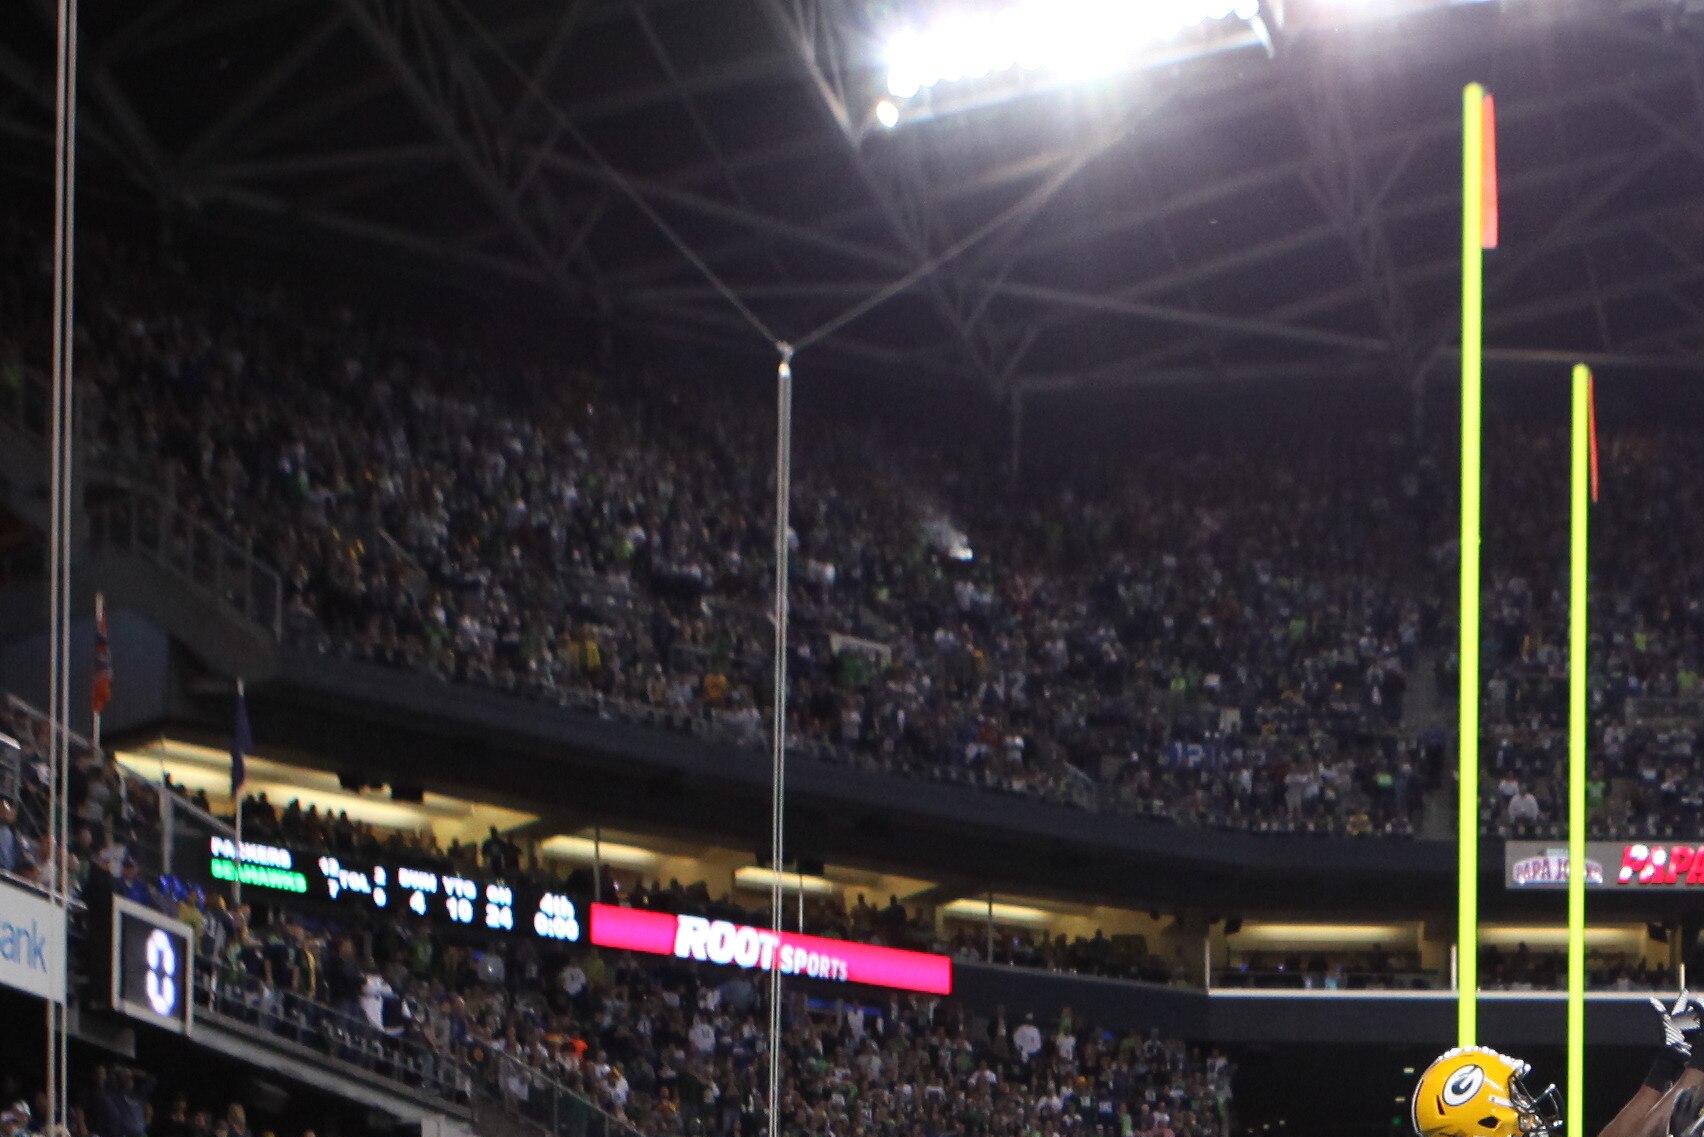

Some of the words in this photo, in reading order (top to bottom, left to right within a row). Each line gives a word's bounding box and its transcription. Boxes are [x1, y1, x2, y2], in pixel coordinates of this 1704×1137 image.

[210, 835, 292, 870] PAKERS
[327, 877, 340, 899] 7
[408, 889, 427, 916] 4
[445, 895, 474, 924] 10
[533, 910, 580, 943] 0:00
[674, 913, 780, 971] ROOT
[779, 943, 848, 983] SPORTS
[145, 927, 176, 1017] 0
